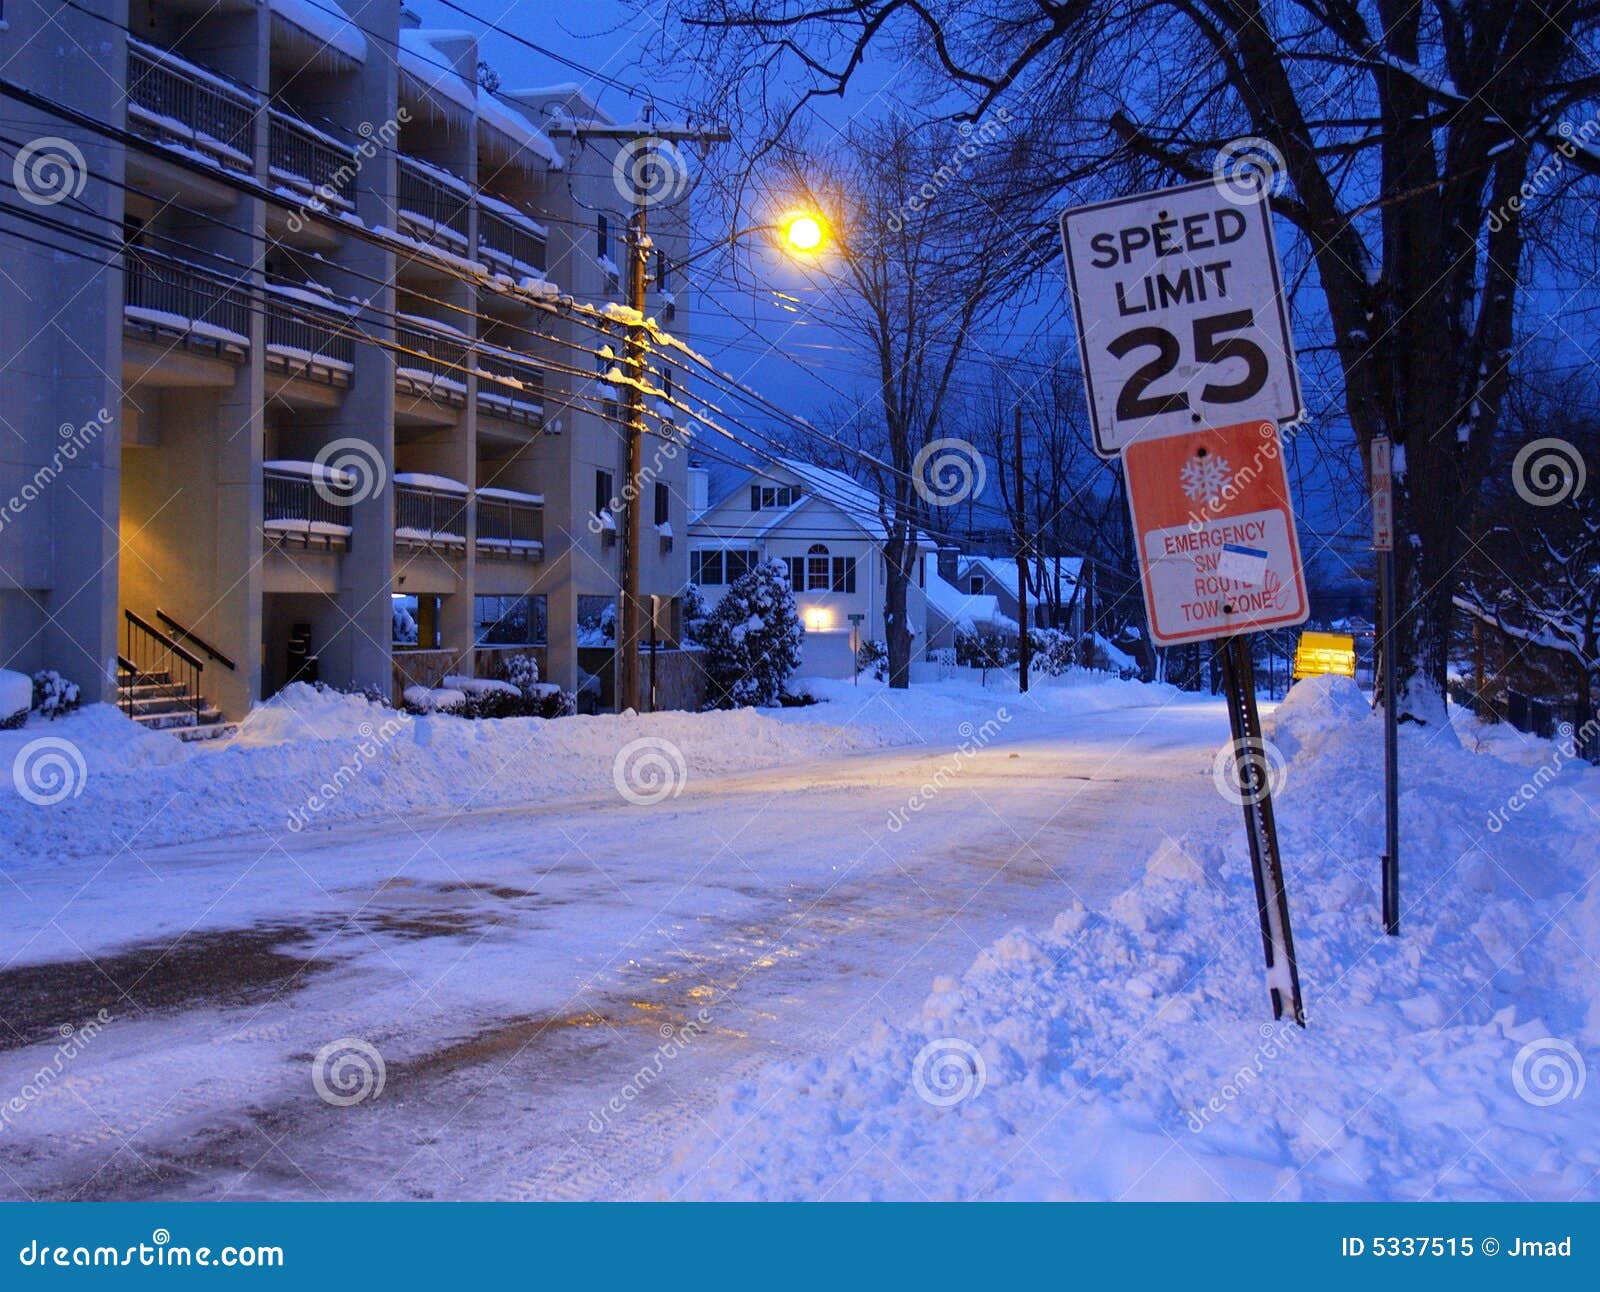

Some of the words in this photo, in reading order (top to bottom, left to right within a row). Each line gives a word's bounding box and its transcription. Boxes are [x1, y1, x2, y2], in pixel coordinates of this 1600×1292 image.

[1090, 208, 1247, 269] SPEED
[1115, 260, 1232, 316] LIMIT
[1106, 308, 1269, 421] 25
[1164, 520, 1266, 555] EMERGENCY
[1181, 600, 1219, 622] TOW
[1228, 590, 1273, 614] ZONE
